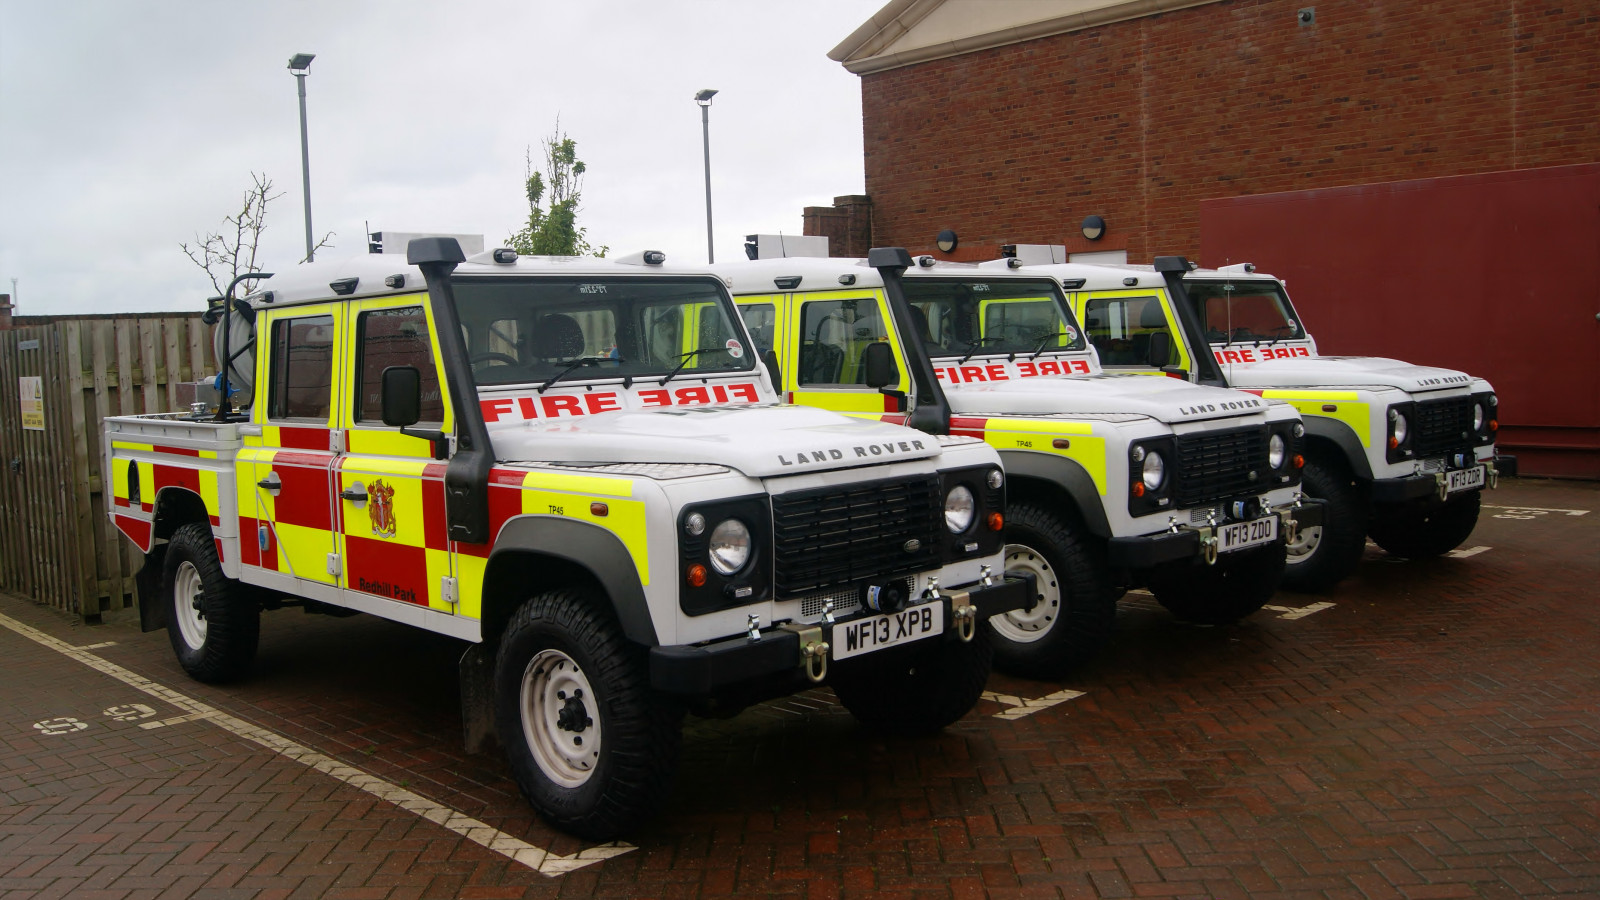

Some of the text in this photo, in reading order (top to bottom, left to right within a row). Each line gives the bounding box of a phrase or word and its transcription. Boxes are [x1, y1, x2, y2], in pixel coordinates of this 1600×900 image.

[1214, 349, 1256, 364] IRE
[1417, 376, 1469, 386] LAND ROVER
[479, 392, 622, 423] FIRE
[1179, 400, 1260, 415] LAND ROVER
[1016, 440, 1033, 448] TP45
[778, 440, 925, 466] LAND ROVER
[1451, 472, 1466, 488] WF13
[548, 504, 564, 516] TP45
[1225, 519, 1271, 547] WF13 ZDO
[359, 576, 416, 602] Redhill Park
[846, 607, 932, 651] WF13 XPB
